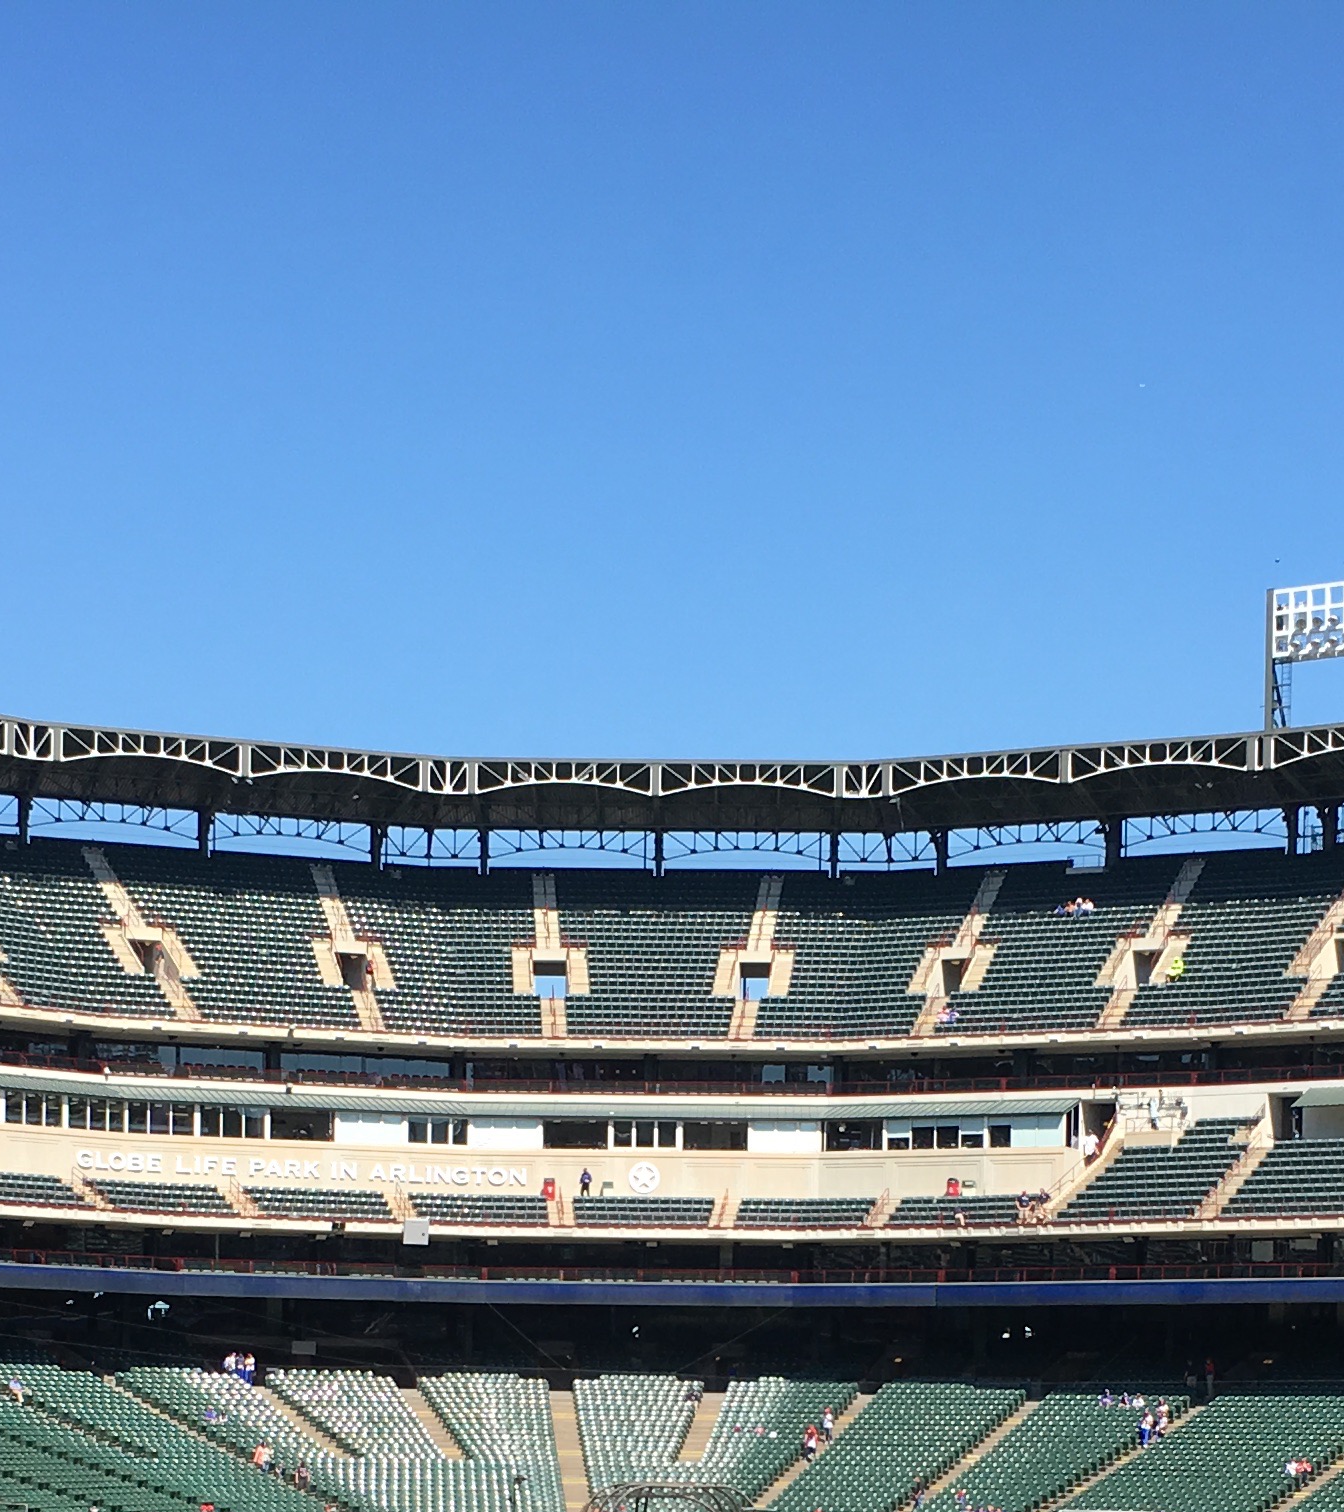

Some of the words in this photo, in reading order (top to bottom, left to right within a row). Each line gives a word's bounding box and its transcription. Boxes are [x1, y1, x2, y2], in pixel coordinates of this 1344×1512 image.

[75, 1150, 163, 1174] GLOBE
[175, 1154, 237, 1177] LIFE
[248, 1158, 321, 1180] PARK
[330, 1161, 358, 1182] IN
[368, 1163, 528, 1187] ARLINGTON
